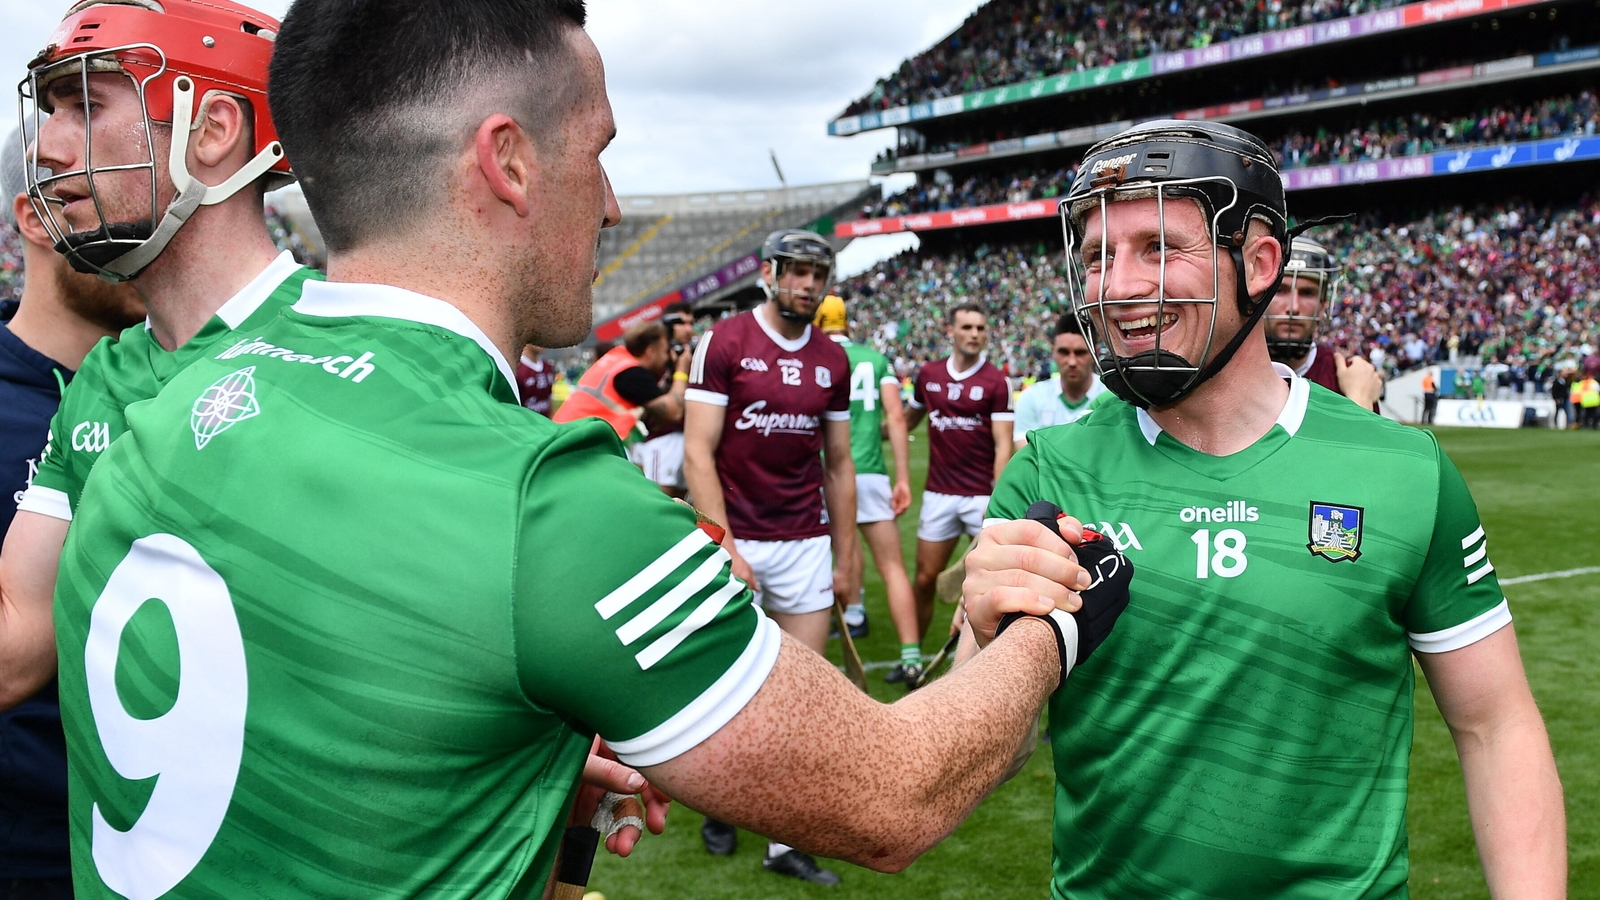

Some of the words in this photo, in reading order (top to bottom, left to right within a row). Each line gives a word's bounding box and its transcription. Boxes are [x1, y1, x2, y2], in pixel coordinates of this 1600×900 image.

[735, 255, 758, 278] AIB
[697, 275, 720, 296] AIB
[781, 366, 802, 386] 12
[1082, 521, 1143, 551] AA
[1190, 528, 1248, 579] 18
[84, 533, 249, 900] 9
